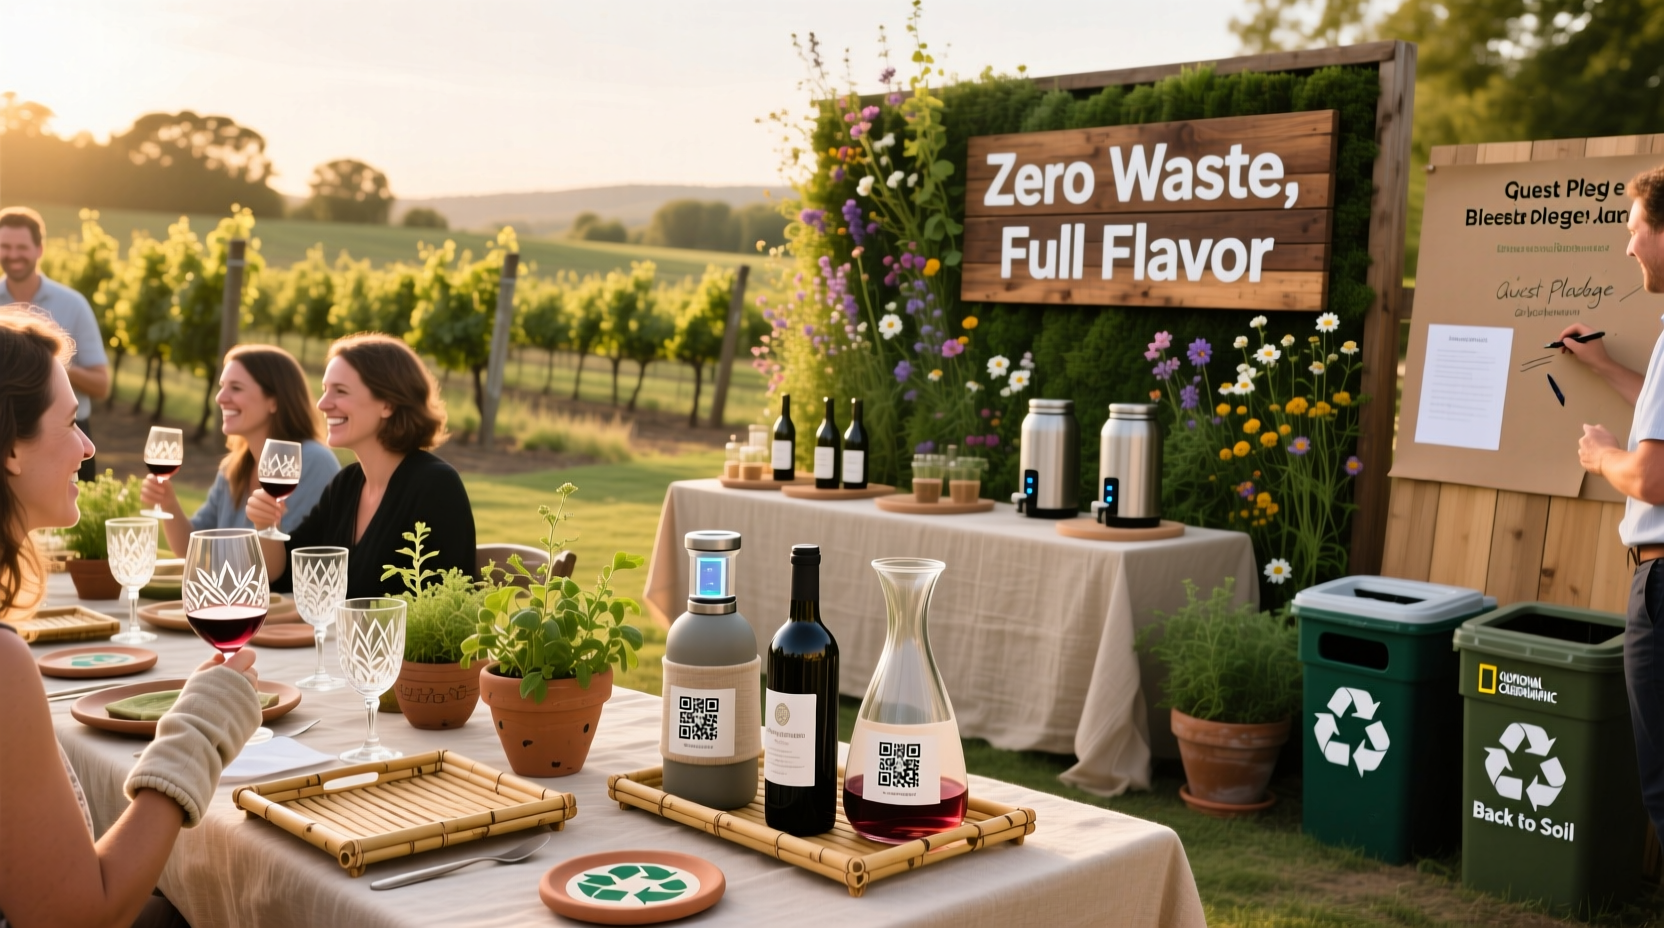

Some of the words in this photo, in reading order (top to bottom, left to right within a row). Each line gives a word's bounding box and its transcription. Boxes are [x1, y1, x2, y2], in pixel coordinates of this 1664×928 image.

[983, 152, 1095, 206] Zero
[1109, 142, 1299, 209] Waste,
[1000, 222, 1085, 280] Full
[1101, 222, 1275, 283] Flavor
[1473, 799, 1514, 827] Back
[1518, 812, 1537, 832] to
[1539, 817, 1575, 842] Soil
